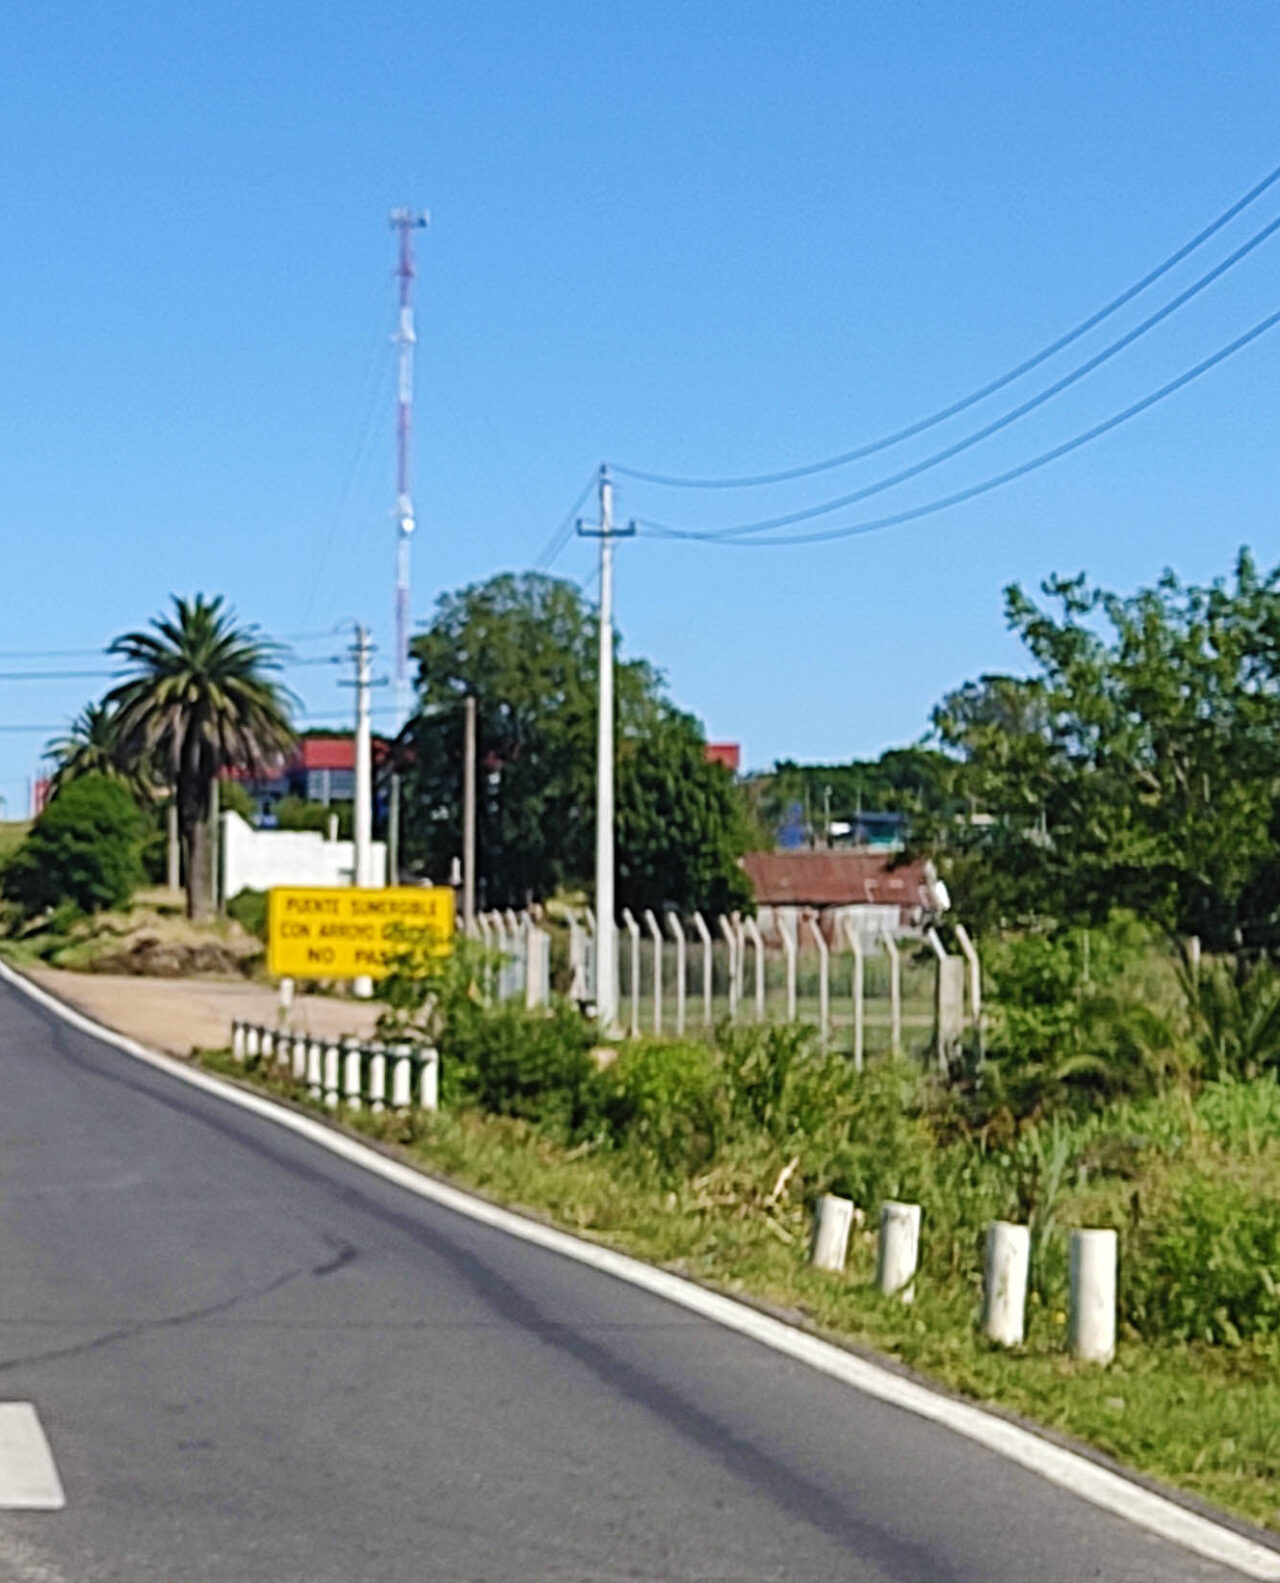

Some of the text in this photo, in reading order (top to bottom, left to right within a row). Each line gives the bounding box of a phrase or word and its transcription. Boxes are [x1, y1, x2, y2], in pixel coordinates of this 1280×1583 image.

[286, 898, 437, 916] PUENTE SUMERGIBLE
[280, 922, 310, 938] CON
[318, 923, 376, 940] ARROYO
[307, 947, 335, 964] NO
